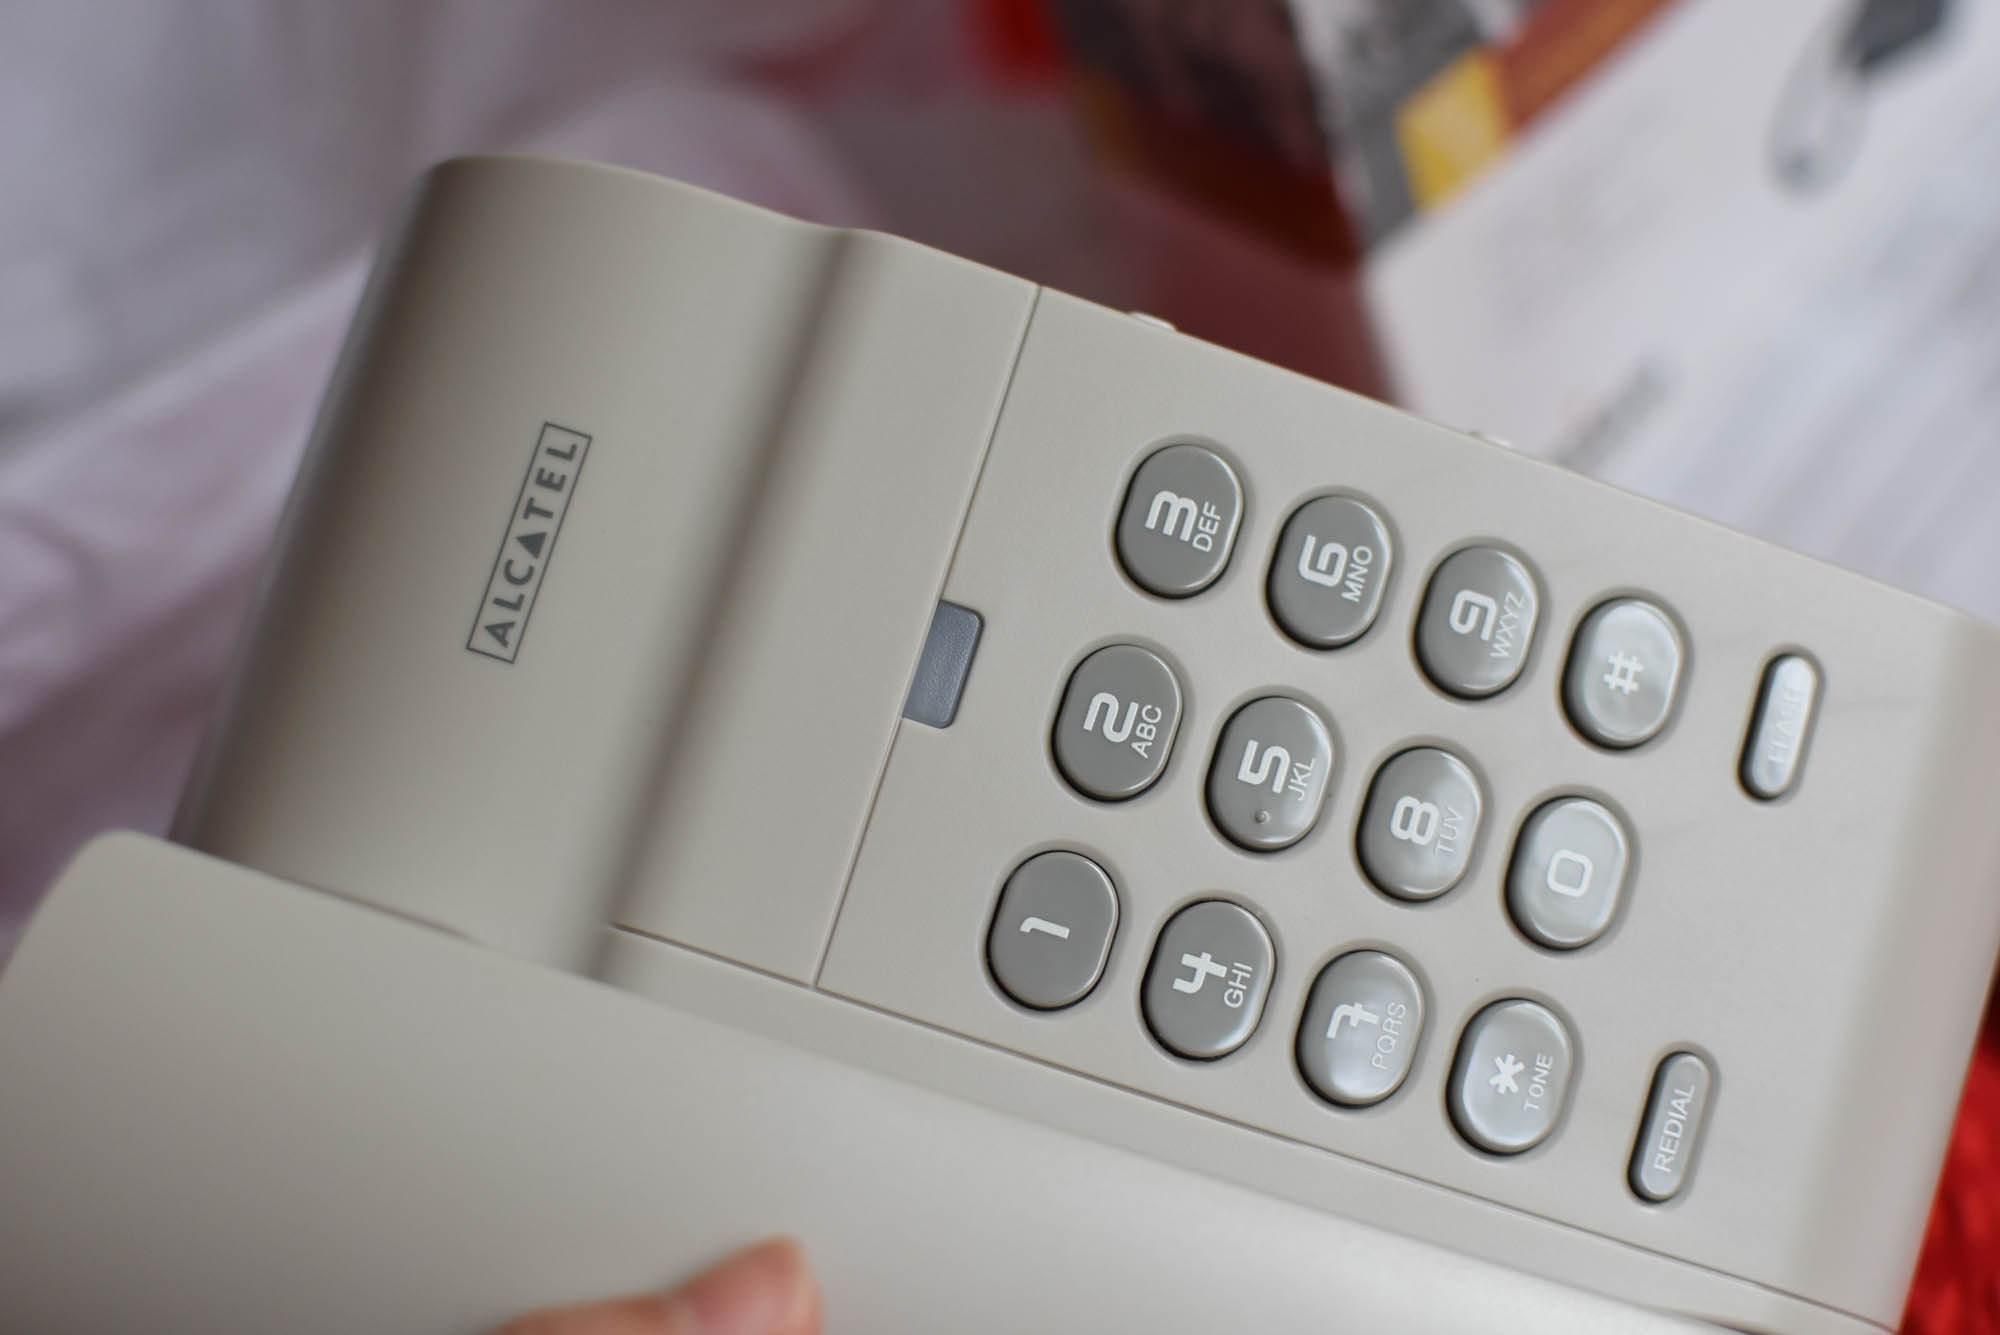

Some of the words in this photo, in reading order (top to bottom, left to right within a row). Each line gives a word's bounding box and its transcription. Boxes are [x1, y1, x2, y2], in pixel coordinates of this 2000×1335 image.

[1145, 491, 1198, 542] 3
[1192, 502, 1221, 552] DEF
[483, 443, 578, 648] ALCATEL
[1298, 535, 1348, 587] 6
[1341, 545, 1373, 602] MNO
[1449, 589, 1498, 641] 9
[1490, 591, 1525, 660] WXYZ
[1083, 692, 1139, 743] 2
[1131, 704, 1162, 758] ABC
[1238, 740, 1291, 793] 5
[1287, 757, 1314, 801] JKL
[1391, 796, 1440, 845] 8
[1434, 807, 1465, 855] TUV
[1020, 917, 1070, 940] 1
[1173, 952, 1227, 993] 4
[1223, 962, 1253, 1008] GHI
[1327, 1002, 1380, 1040] 7
[1371, 1001, 1407, 1070] PQRS
[1523, 1052, 1554, 1112] TONE
[1653, 1083, 1696, 1173] REDIAL
